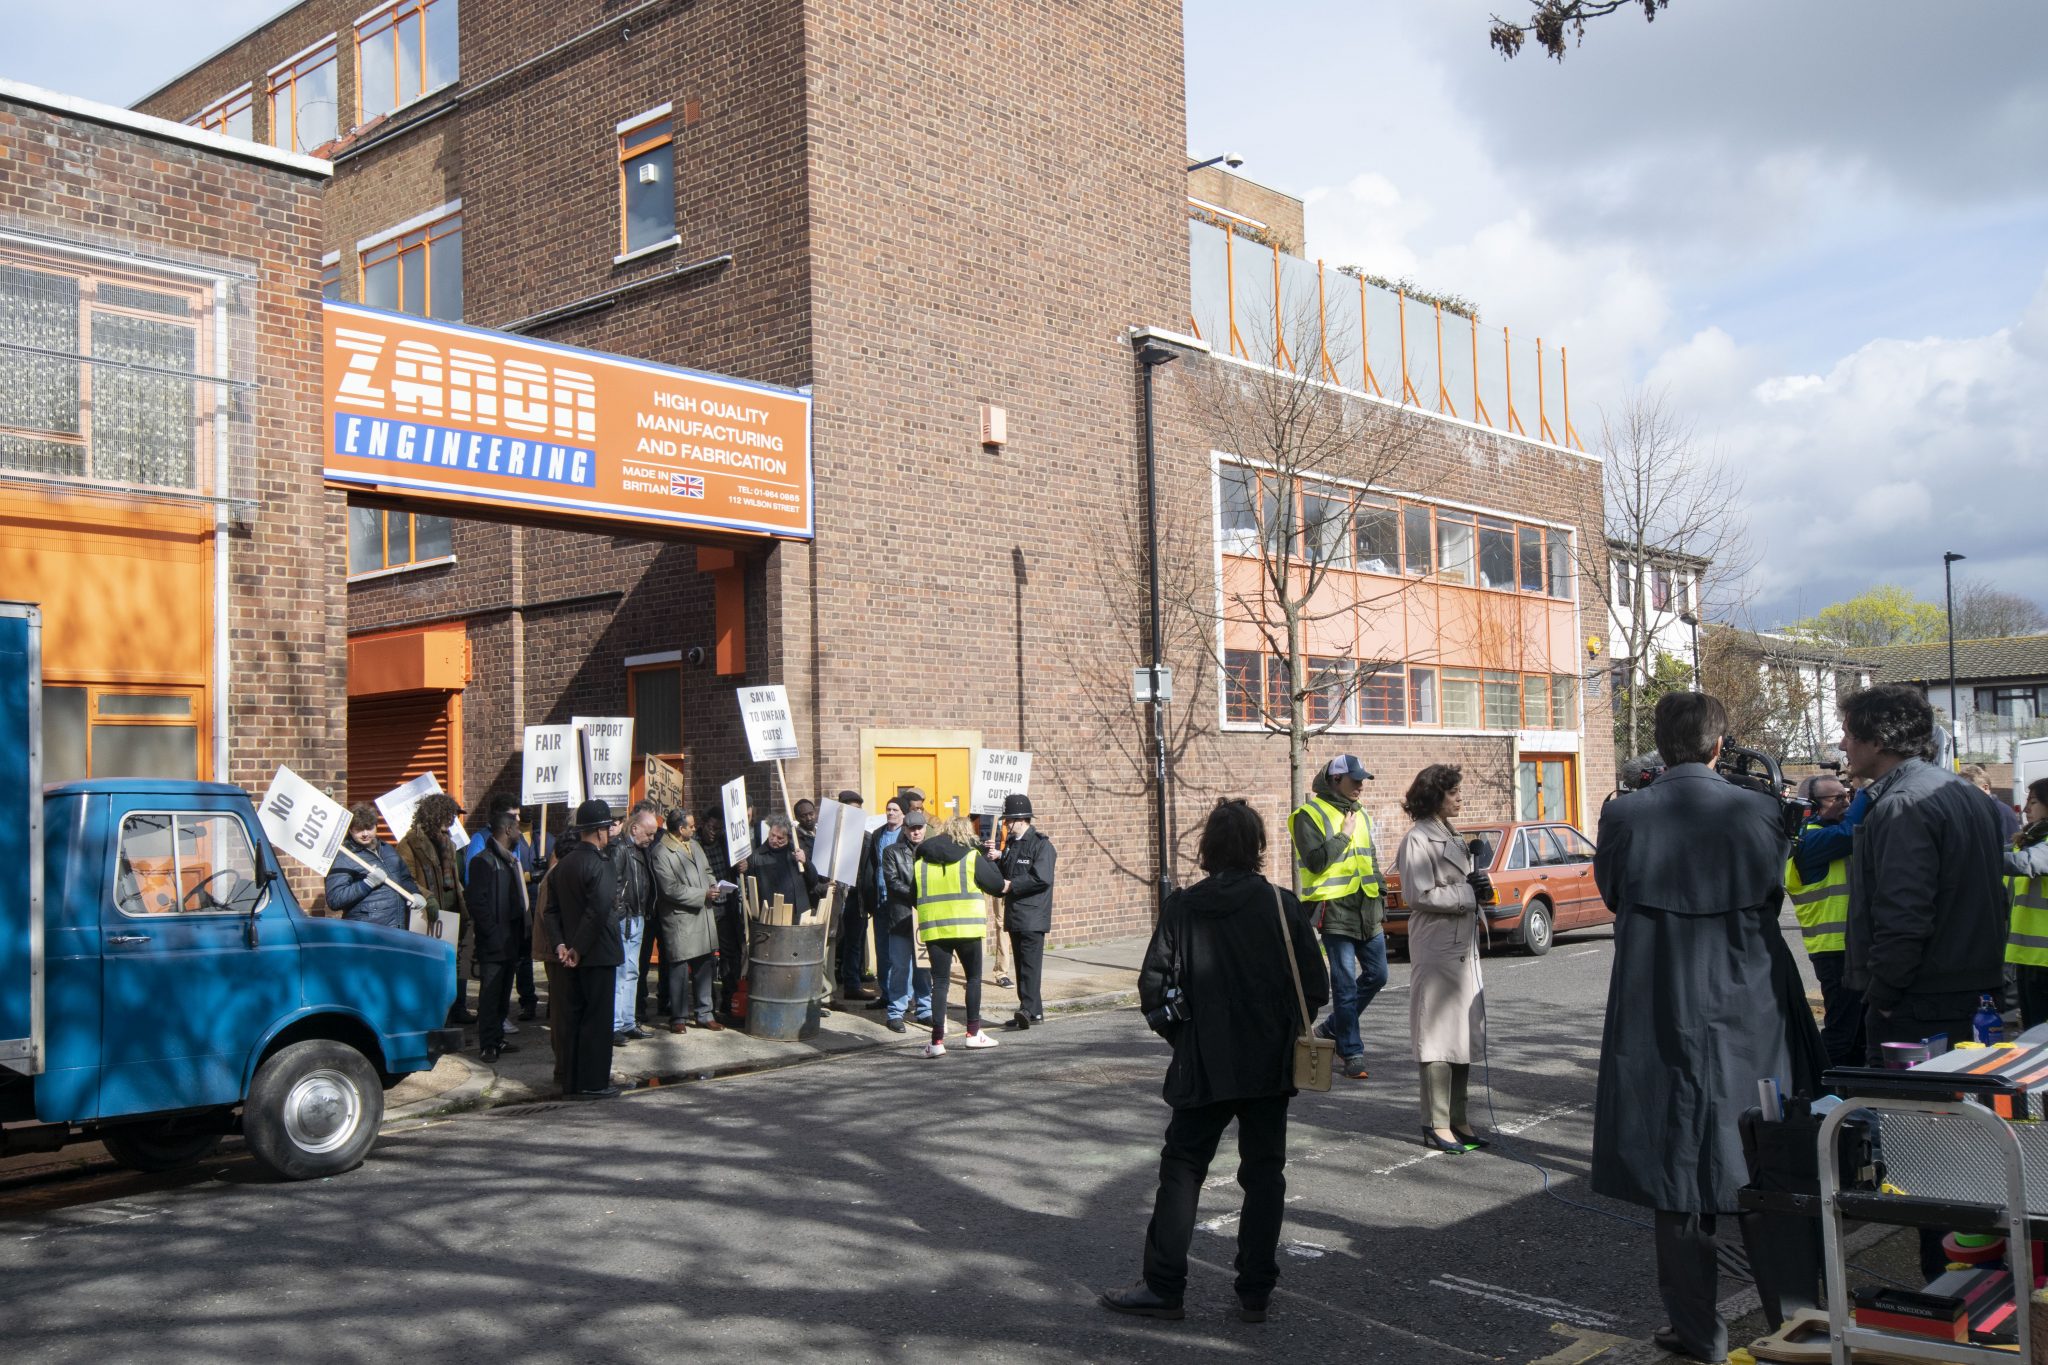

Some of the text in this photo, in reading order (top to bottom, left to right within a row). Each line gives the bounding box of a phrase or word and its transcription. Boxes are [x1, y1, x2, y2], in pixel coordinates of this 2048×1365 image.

[654, 391, 769, 426] HIGH QUALITY
[637, 412, 784, 452] MANUFACTURING
[344, 417, 588, 484] ENGINEERING
[637, 437, 787, 475] AND FABRICATION
[622, 466, 669, 481] MADE IN
[622, 480, 669, 495] BRITIAN
[728, 495, 800, 513] 112 WILSON STREET
[750, 690, 776, 703] SAY NO
[749, 709, 786, 722] TO UNFAIR
[535, 733, 561, 751] FAIR
[762, 727, 783, 741] CUTS!
[593, 748, 610, 761] THE
[989, 753, 1018, 766] SAY NO
[536, 765, 558, 783] PAY
[593, 772, 622, 786] RKERS
[982, 770, 1023, 783] TO UNFAIR
[267, 792, 294, 822] NO
[730, 787, 739, 809] NO
[294, 804, 328, 850] CUTS
[730, 819, 746, 842] CUTS
